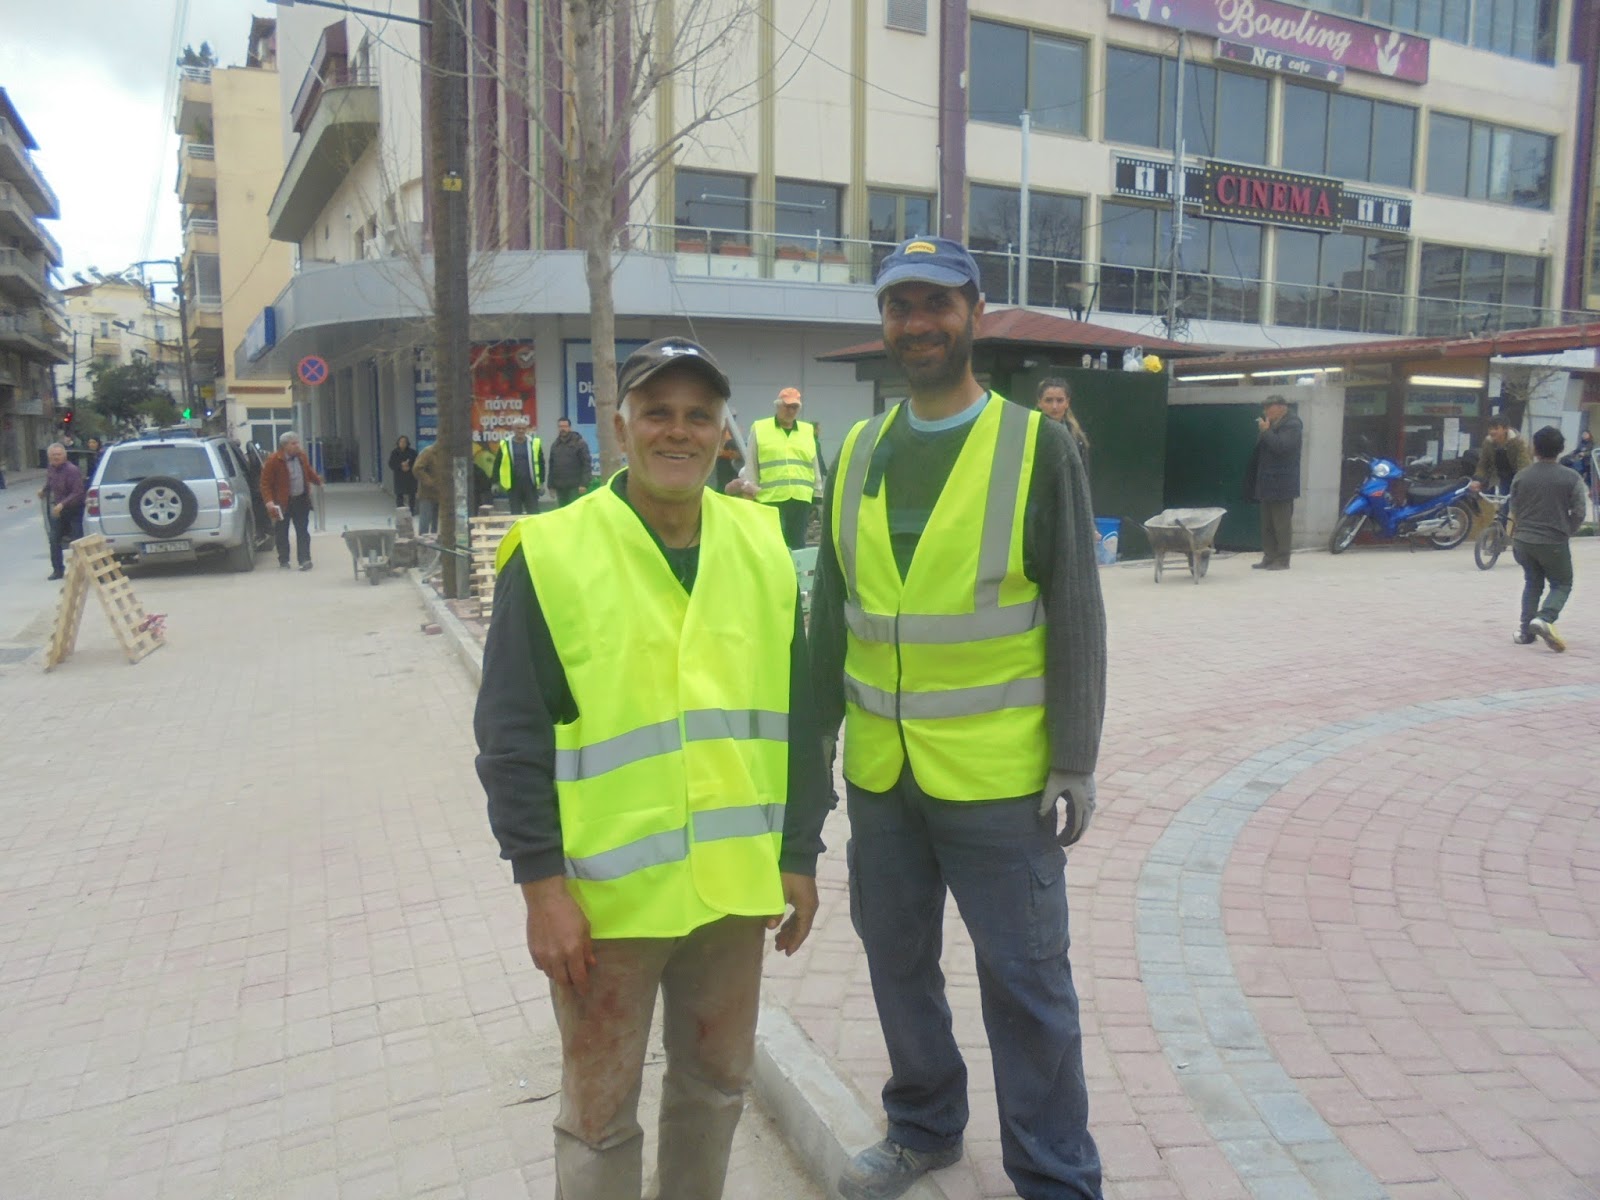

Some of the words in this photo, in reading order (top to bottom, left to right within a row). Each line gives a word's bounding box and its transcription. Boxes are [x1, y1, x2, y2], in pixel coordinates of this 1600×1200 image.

[1217, 0, 1352, 60] Bowling
[1250, 46, 1283, 70] Net
[1216, 174, 1332, 218] CINEMA
[485, 396, 523, 410] πάντα
[472, 430, 482, 442] &
